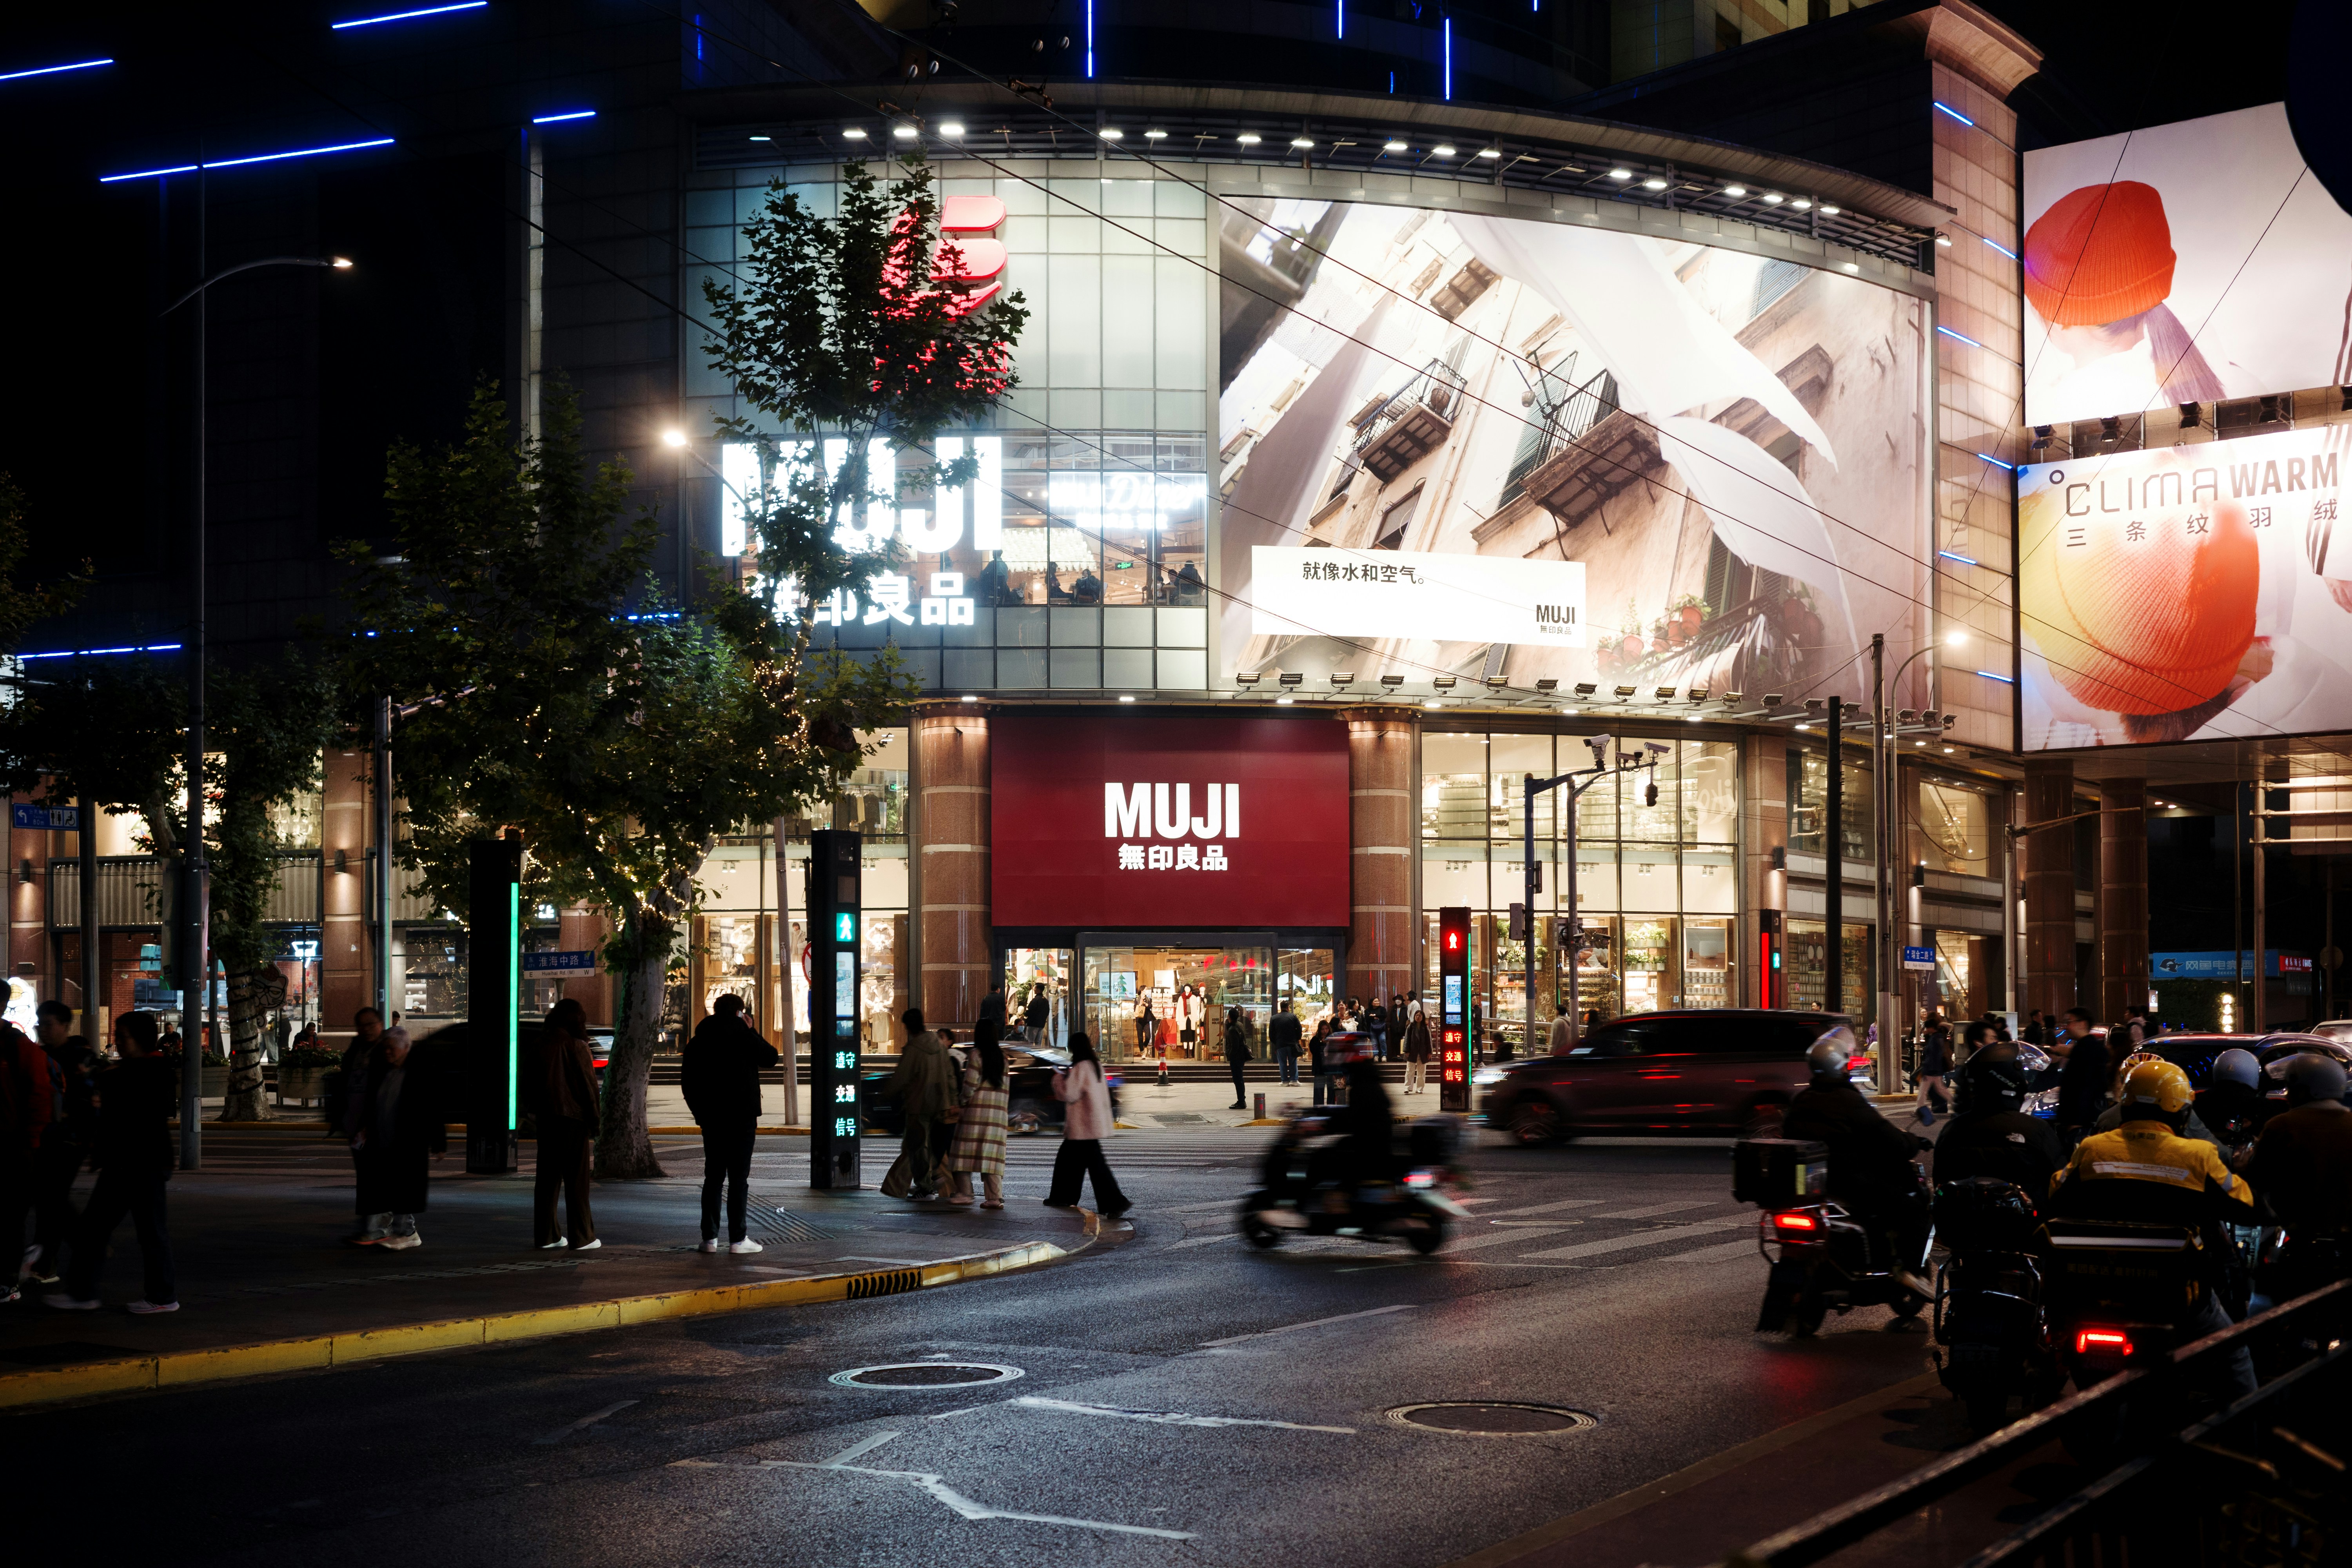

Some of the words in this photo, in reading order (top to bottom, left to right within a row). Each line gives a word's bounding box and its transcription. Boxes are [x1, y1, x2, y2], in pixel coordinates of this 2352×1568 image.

[2067, 498, 2338, 547] 三条纹羽绒
[1302, 562, 1424, 585] 就像水和空气。
[1536, 604, 1575, 624] MUJI
[1540, 625, 1572, 635] 無印良品
[1105, 782, 1240, 839] MUJI
[1118, 843, 1228, 871] 無印良品
[539, 955, 579, 967] 淮海中路
[1445, 1033, 1462, 1043] 遵守
[835, 1051, 855, 1069] 遵守
[1445, 1051, 1462, 1062] 交通
[1446, 1070, 1463, 1081] 信号
[835, 1085, 855, 1102] 交通
[835, 1118, 856, 1136] 信号
